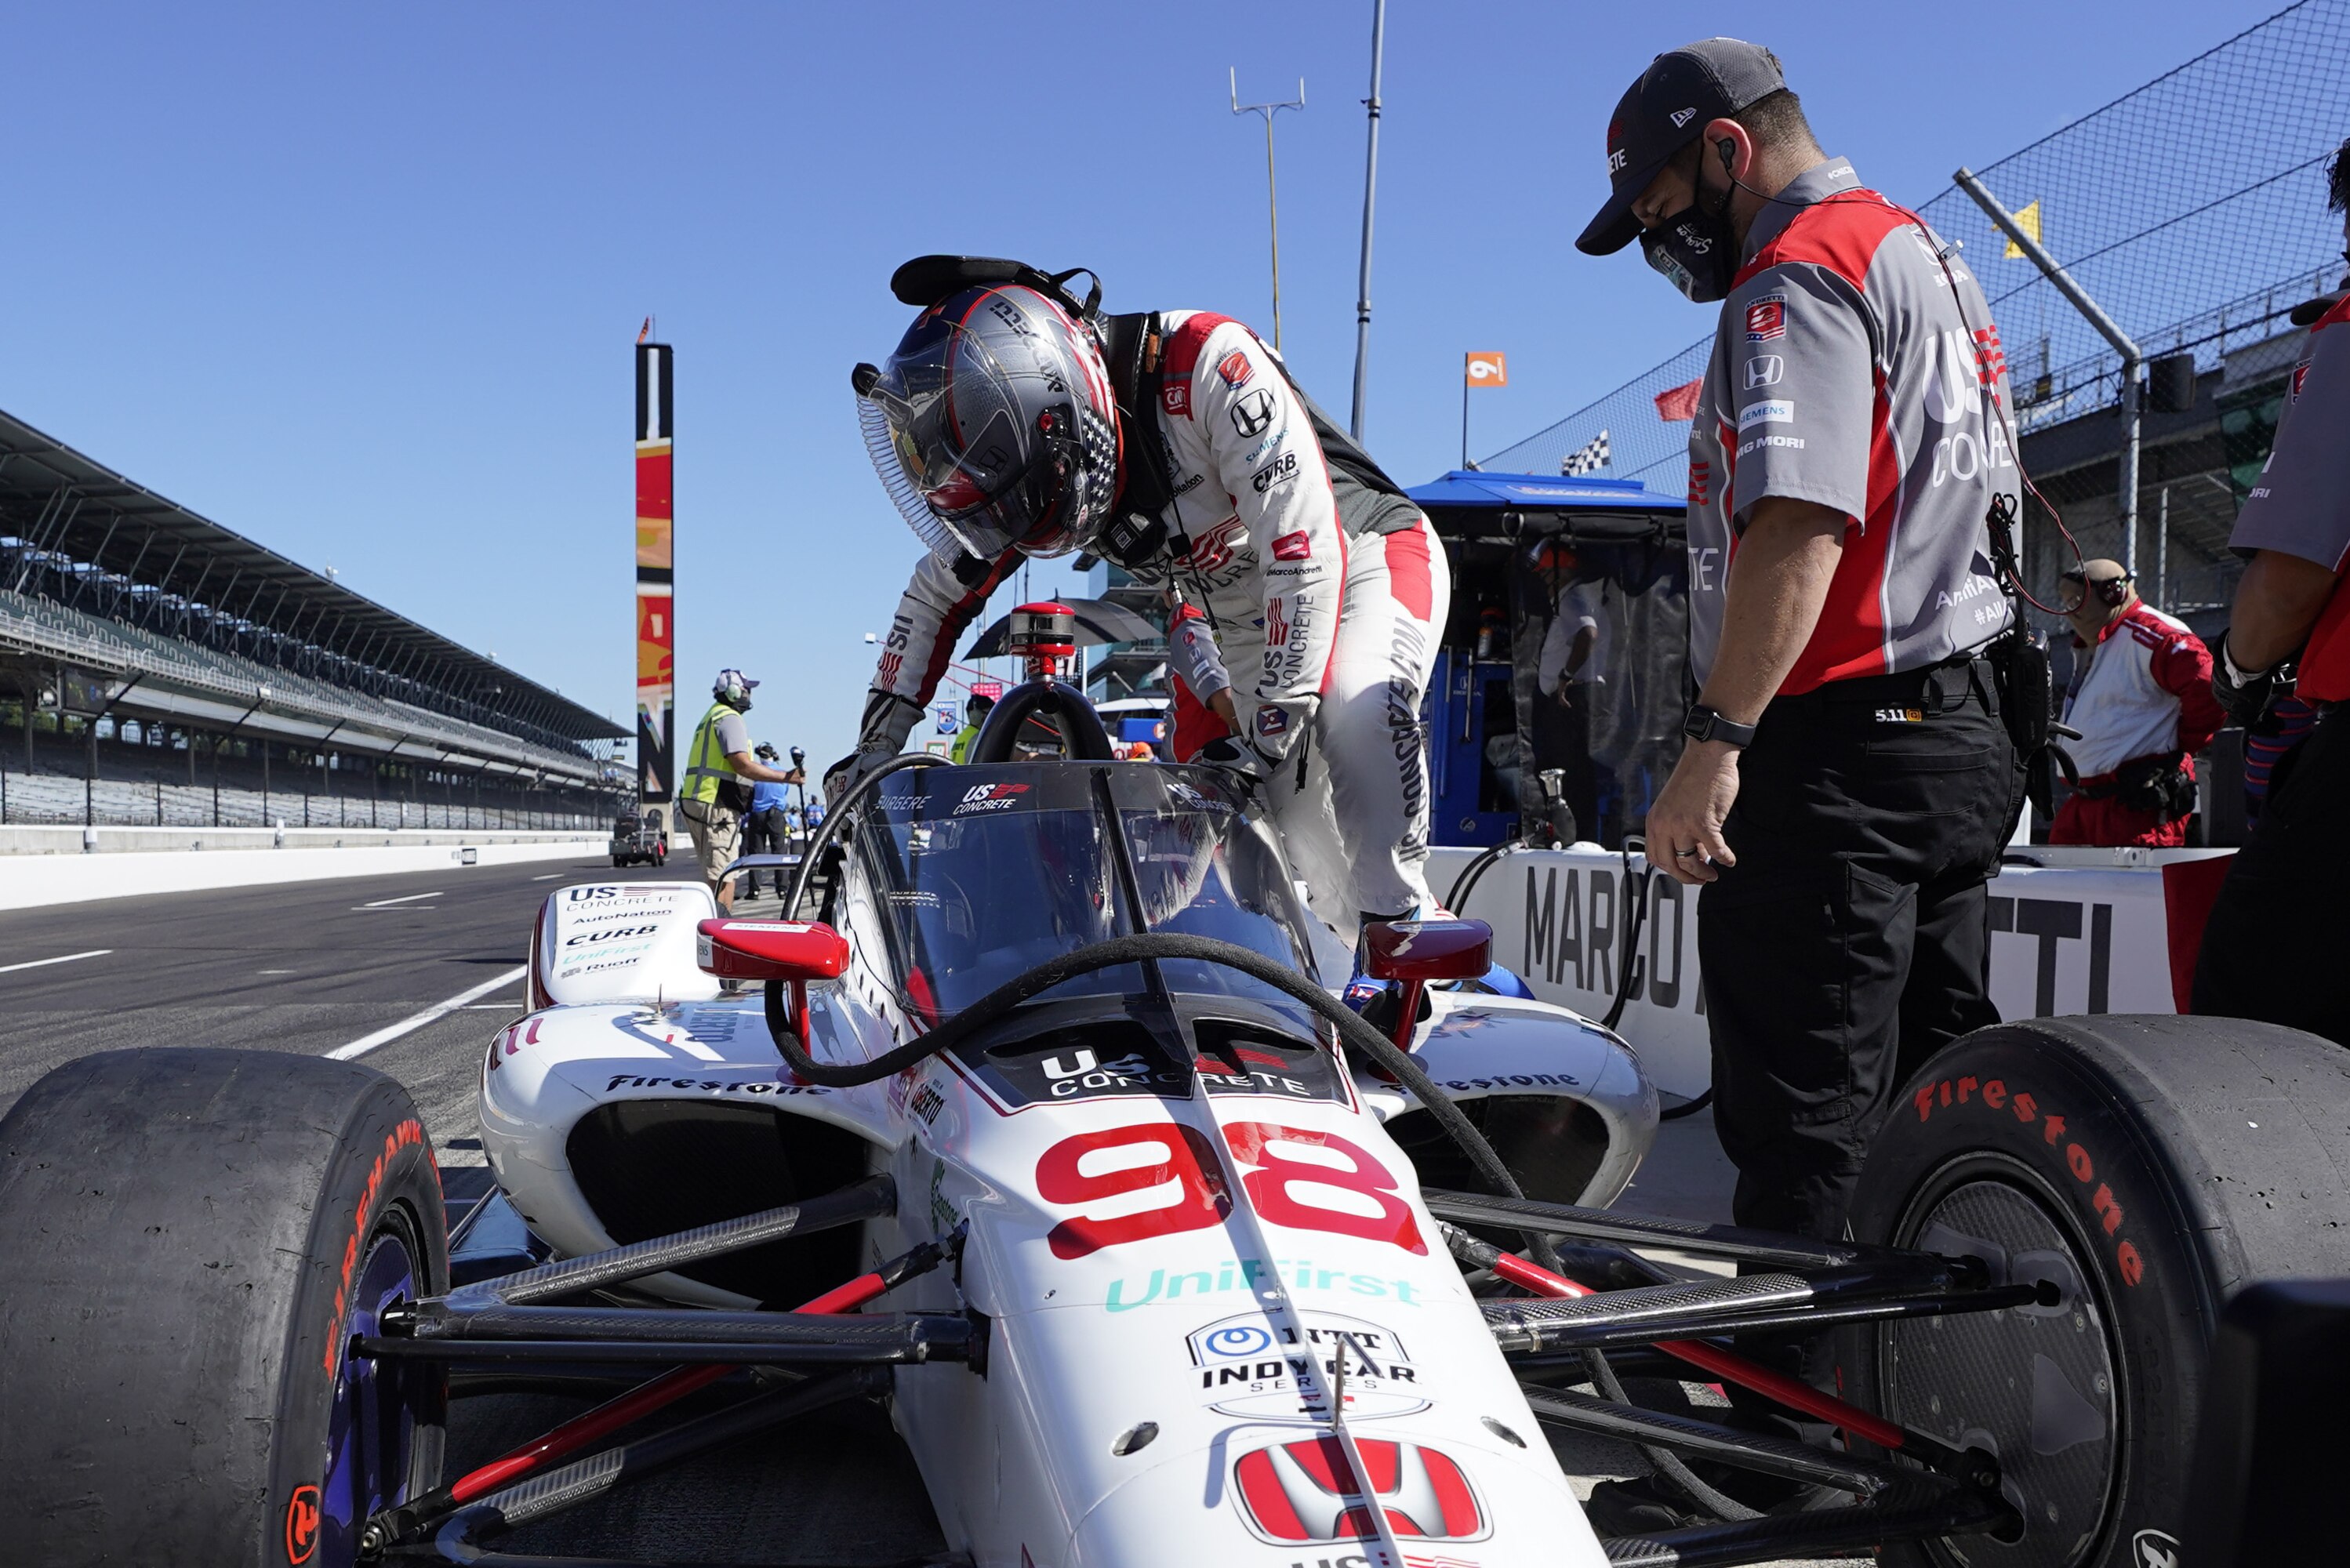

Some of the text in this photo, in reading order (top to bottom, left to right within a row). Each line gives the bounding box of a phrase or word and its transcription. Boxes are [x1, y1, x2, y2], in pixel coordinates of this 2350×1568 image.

[1923, 326, 1982, 424] US
[1756, 435, 1806, 450] MORI
[887, 615, 913, 652] US
[1259, 651, 1284, 688] US
[1875, 709, 1907, 723] 5.11
[875, 795, 932, 811] SURGERE
[962, 783, 996, 803] US
[953, 798, 1016, 815] CONCRETE
[566, 895, 680, 913] CONCRETE
[570, 887, 618, 902] US
[572, 909, 673, 925] AutoNation
[566, 925, 659, 946] CURB
[1524, 866, 1684, 1009] MARCO
[562, 943, 652, 965] UniFirst
[587, 957, 641, 971] Ruoff
[1041, 1049, 1151, 1080] US
[605, 1073, 832, 1096] Firestone
[1050, 1070, 1311, 1097] CONCRETE
[1379, 1073, 1580, 1095] Festone
[910, 1083, 945, 1127] OBERTO
[1035, 1120, 1429, 1261] 98
[1913, 1075, 2144, 1288] Firestone
[1104, 1258, 1423, 1313] UniFirst
[1202, 1359, 1415, 1389] INDYCAR
[1250, 1375, 1378, 1393] SERES
